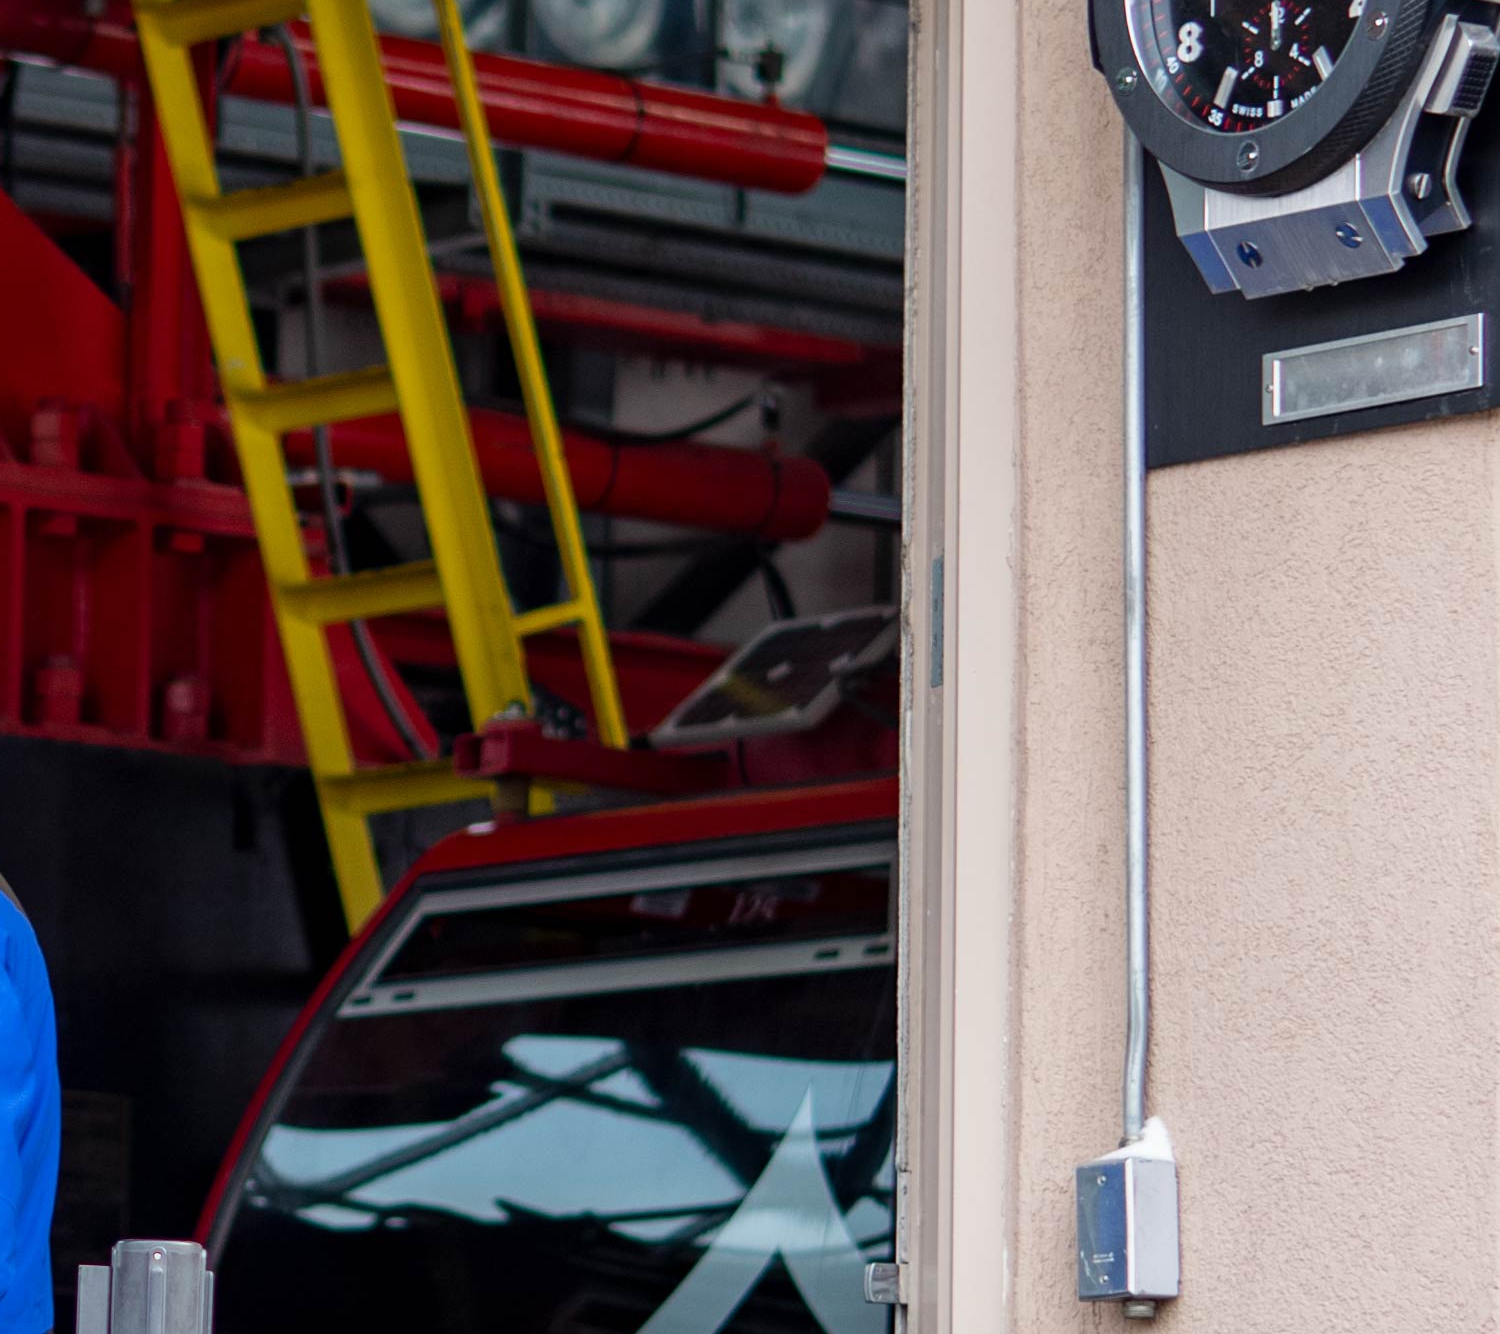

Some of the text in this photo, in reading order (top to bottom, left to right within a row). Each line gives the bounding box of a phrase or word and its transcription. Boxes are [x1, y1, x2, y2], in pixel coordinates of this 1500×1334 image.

[1177, 21, 1203, 63] 8
[1254, 50, 1264, 68] 8
[1289, 43, 1300, 61] 4
[1166, 56, 1179, 74] 40
[1208, 109, 1223, 126] 35
[1232, 103, 1263, 118] SWISS
